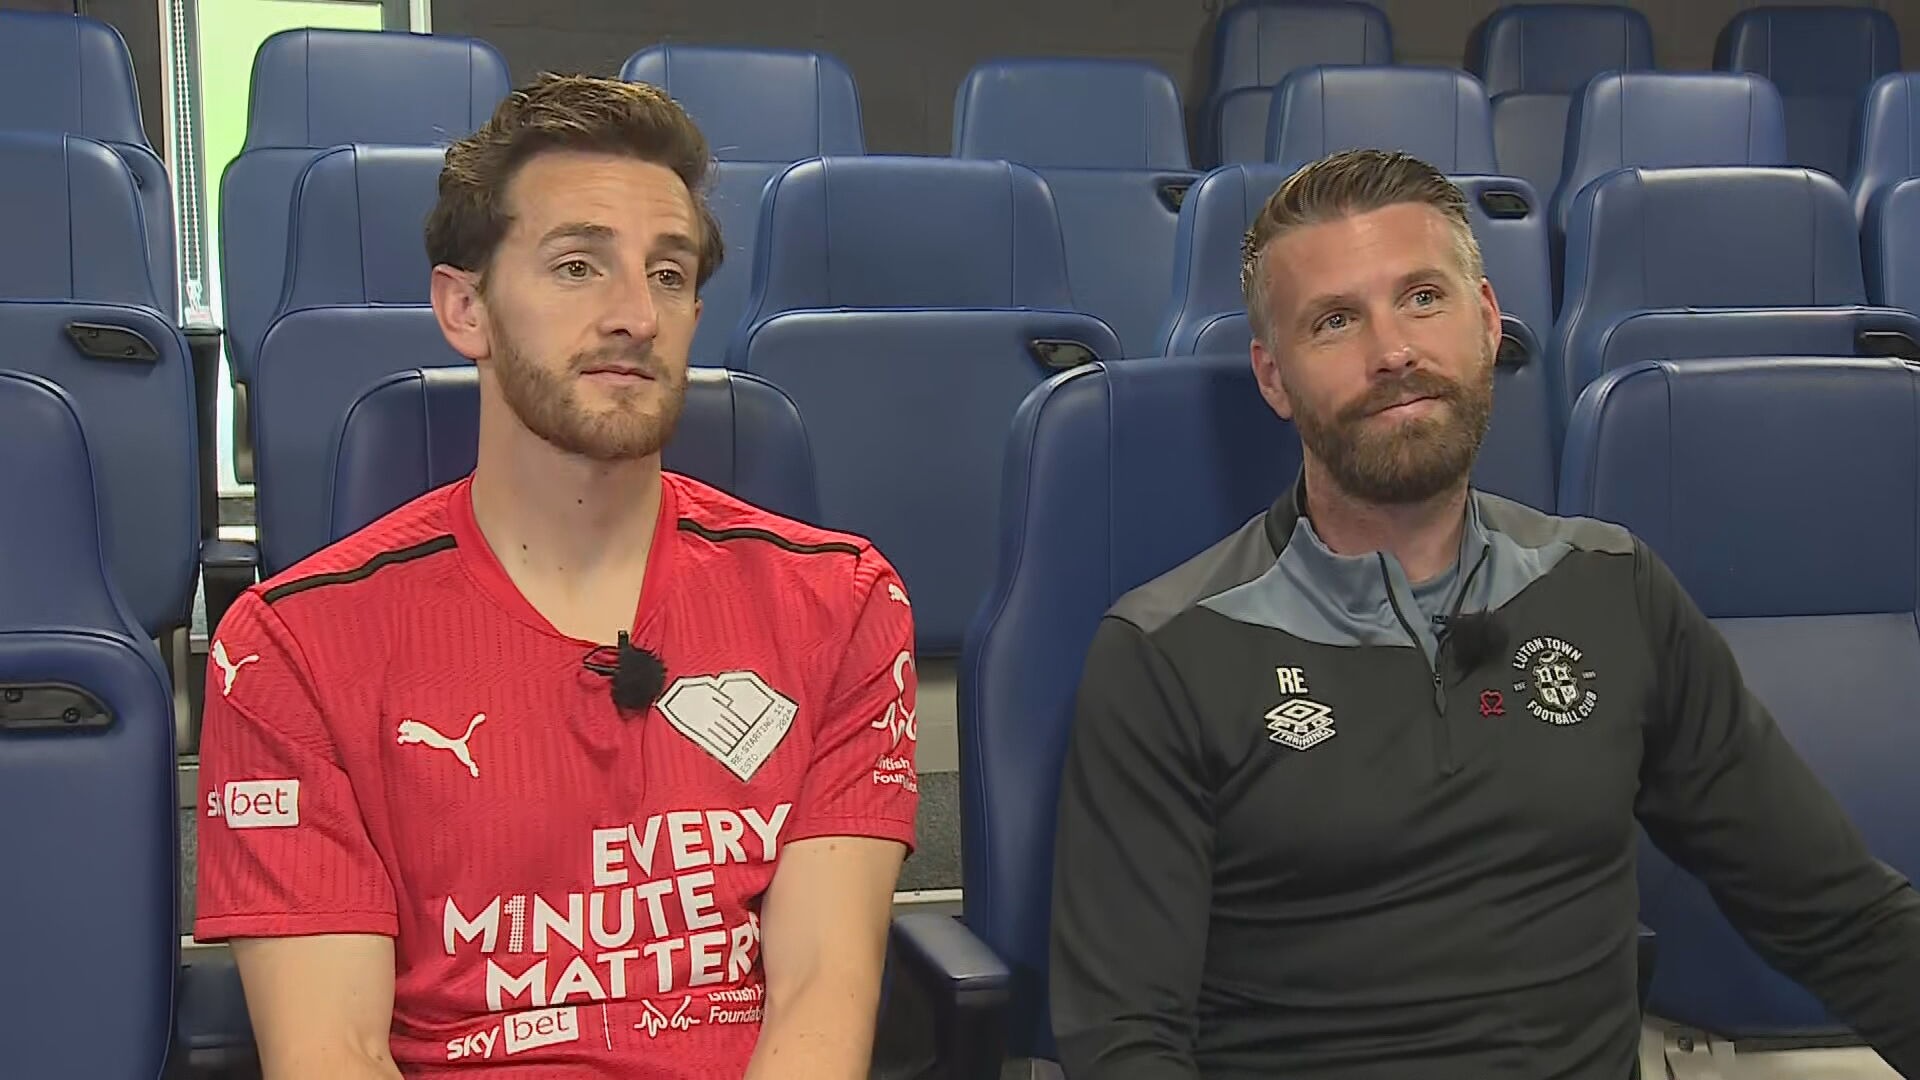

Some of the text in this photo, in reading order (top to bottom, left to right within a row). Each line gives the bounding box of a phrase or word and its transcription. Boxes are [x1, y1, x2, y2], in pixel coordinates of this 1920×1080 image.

[1512, 637, 1582, 669] LUTON TOWN
[1276, 667, 1308, 694] RE
[1527, 690, 1598, 724] FOOTBALL CLUB
[231, 786, 290, 817] bet
[592, 803, 793, 887] EVERY
[443, 871, 724, 955] M1NUTE
[512, 1009, 570, 1041] bet
[709, 1005, 763, 1024] Foundat
